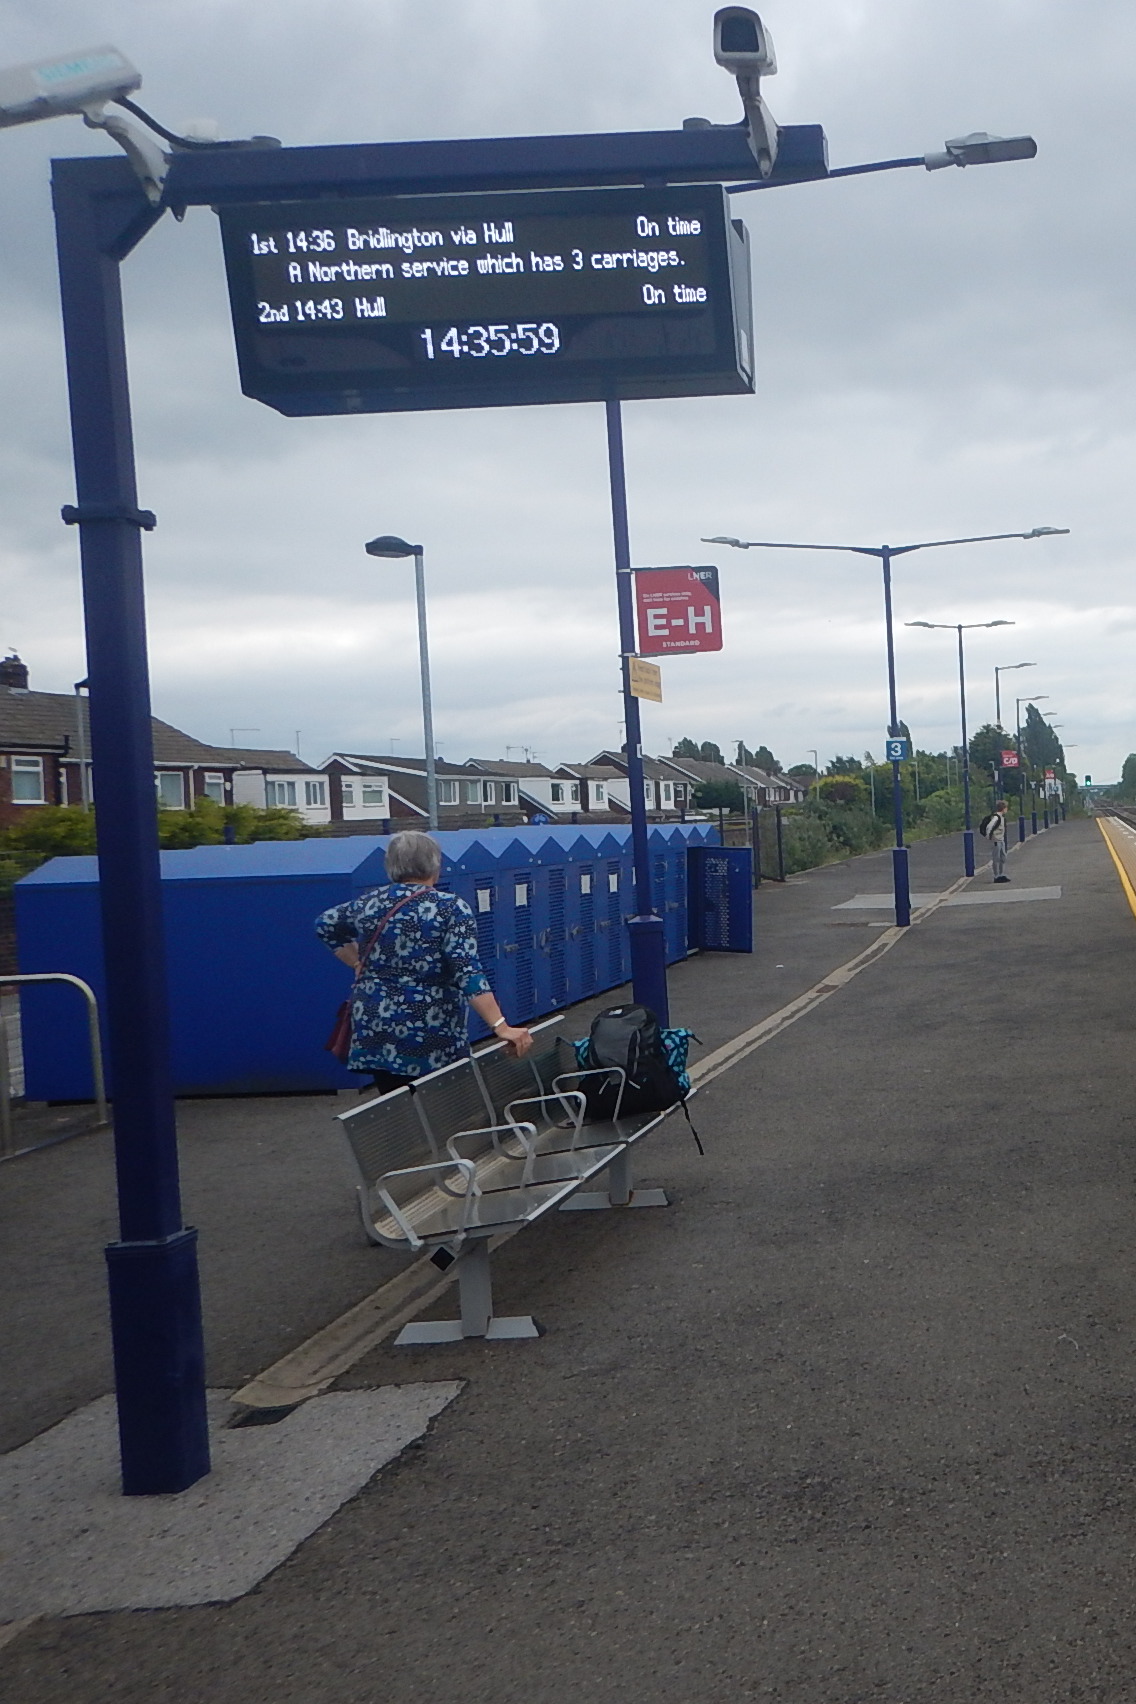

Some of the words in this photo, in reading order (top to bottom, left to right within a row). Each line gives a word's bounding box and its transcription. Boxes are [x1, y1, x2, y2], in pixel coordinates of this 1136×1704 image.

[250, 233, 279, 254] 1st
[286, 230, 336, 253] 14:36
[346, 227, 444, 254] Bridlington
[450, 226, 477, 245] via
[482, 222, 514, 244] Hull
[636, 216, 660, 237] On
[667, 216, 702, 236] time
[288, 262, 303, 284] A
[307, 260, 395, 283] Northern
[401, 257, 470, 278] service
[476, 252, 525, 274] which
[530, 251, 565, 272] has
[571, 248, 584, 270] 3
[590, 248, 686, 273] carriages.
[642, 284, 666, 305] On
[673, 284, 708, 303] time
[257, 301, 290, 323] 2nd
[294, 298, 344, 321] 14:43
[354, 296, 387, 318] Hull
[420, 322, 561, 360] 14:35:59
[687, 571, 713, 581] LNER
[646, 605, 713, 637] E-H
[662, 639, 701, 648] STANDARD
[890, 742, 902, 757] 3
